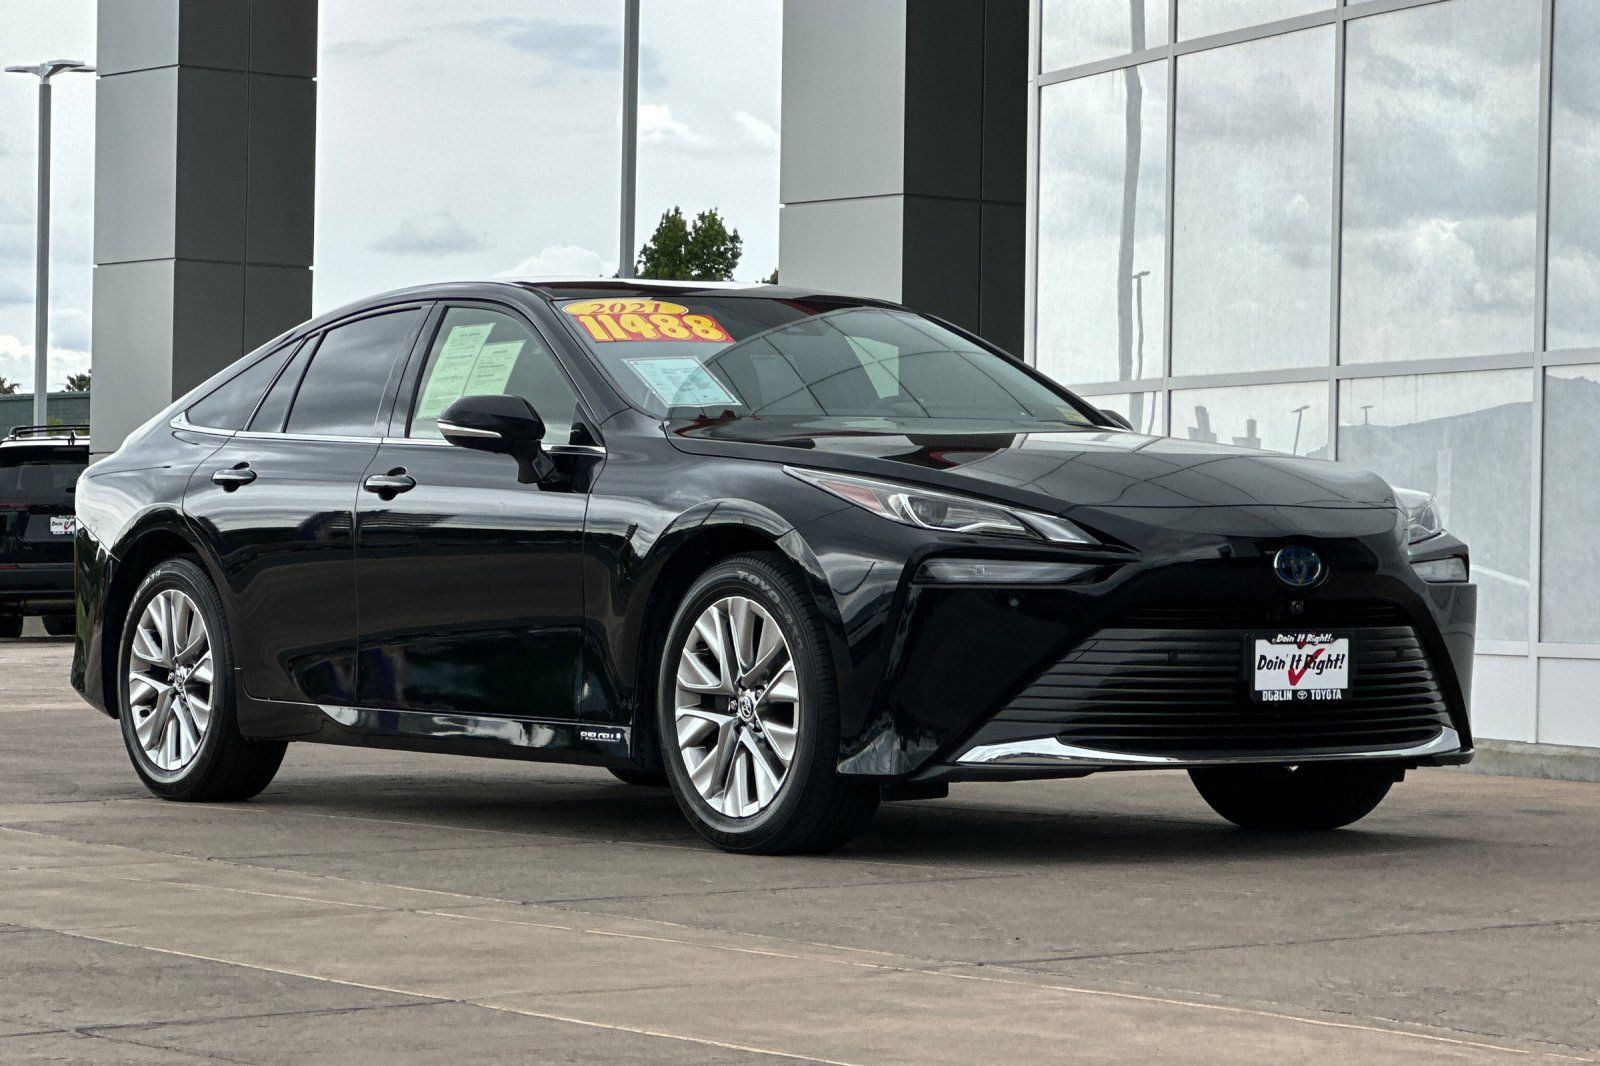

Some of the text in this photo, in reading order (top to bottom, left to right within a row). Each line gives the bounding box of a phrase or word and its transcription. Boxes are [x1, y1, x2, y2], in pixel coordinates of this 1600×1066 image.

[590, 302, 661, 314] 2021
[579, 313, 726, 341] 11488
[736, 570, 781, 604] TOYO
[1297, 633, 1306, 642] It
[1306, 633, 1332, 644] Right!
[1257, 653, 1346, 676] Doin' It Right!
[1262, 688, 1342, 702] DUBLIN TOYOTA
